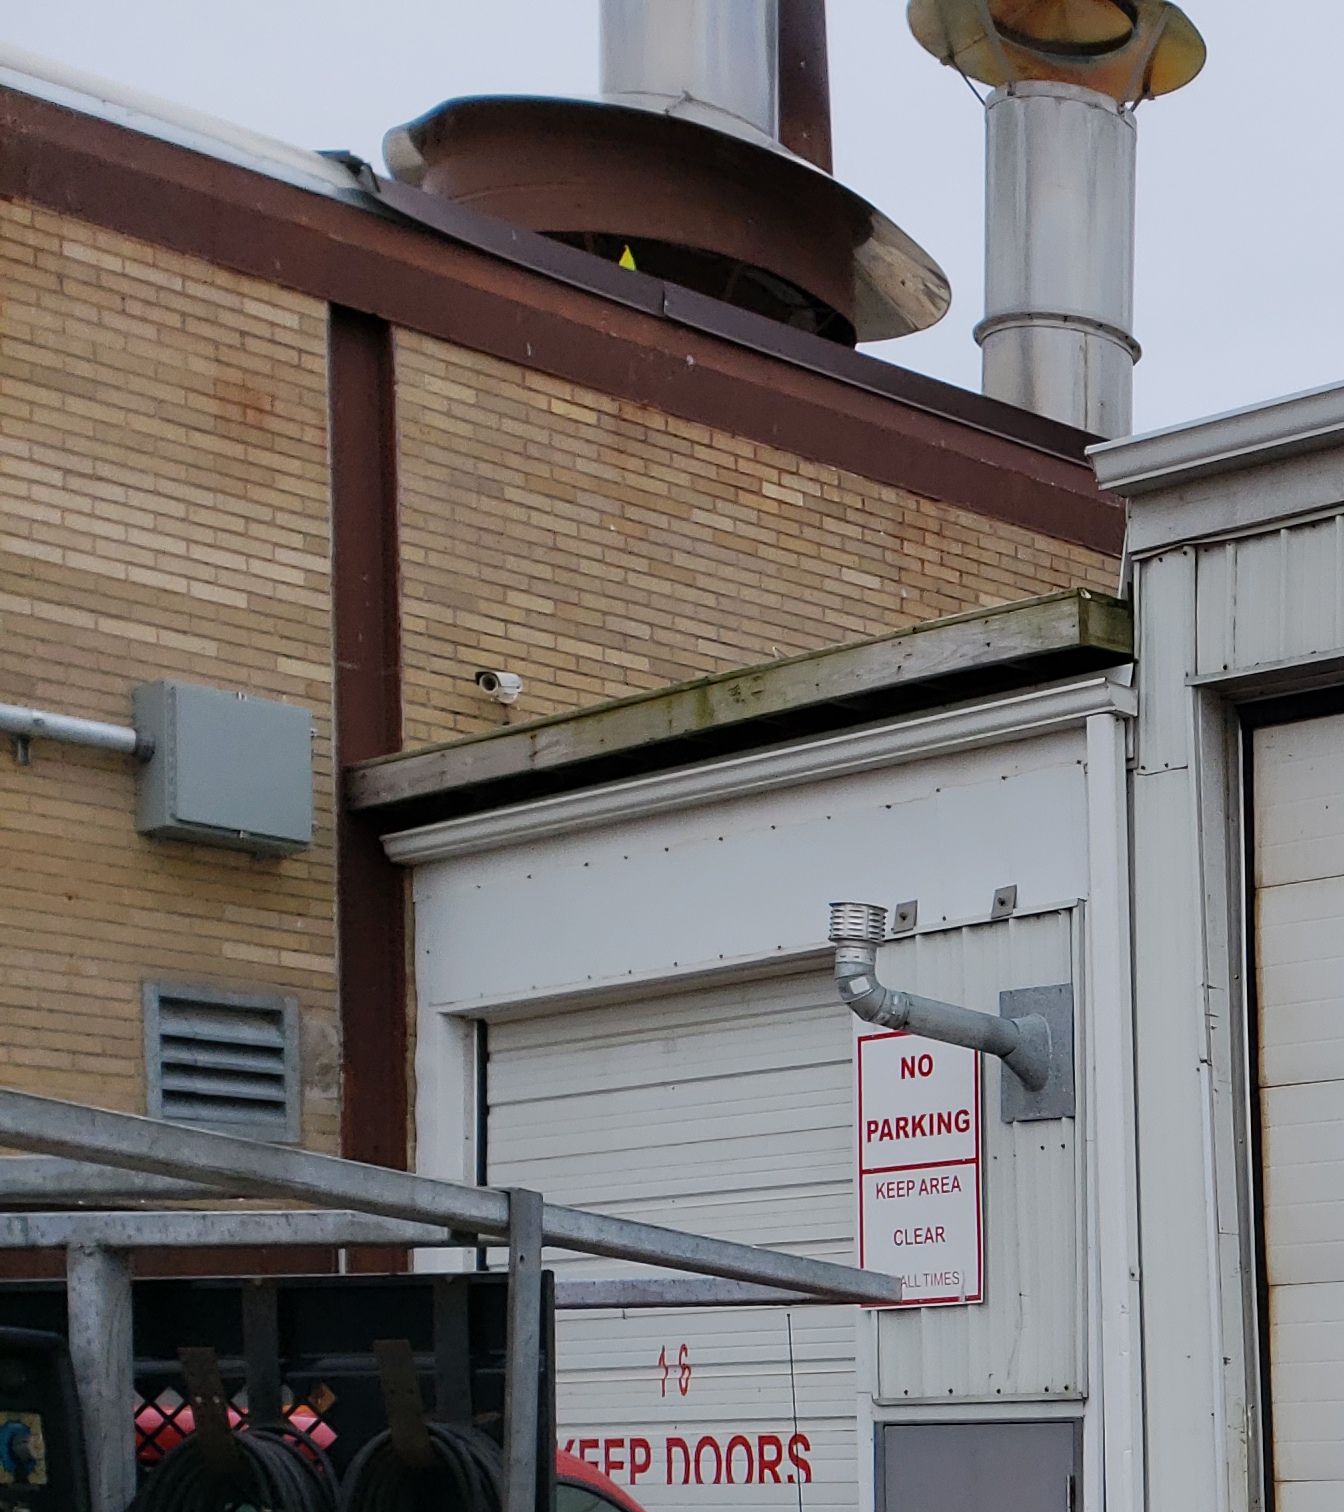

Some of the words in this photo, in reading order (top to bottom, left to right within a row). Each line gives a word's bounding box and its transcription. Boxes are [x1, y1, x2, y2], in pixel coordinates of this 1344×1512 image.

[900, 1053, 934, 1079] NO
[866, 1109, 971, 1143] PARKING
[876, 1179, 916, 1200] KEEP
[918, 1175, 962, 1196] AREA
[893, 1226, 945, 1246] CLEAR
[900, 1273, 921, 1288] ALL
[922, 1271, 960, 1286] TIMES
[563, 1438, 651, 1485] EEP
[666, 1434, 812, 1484] DOORS
